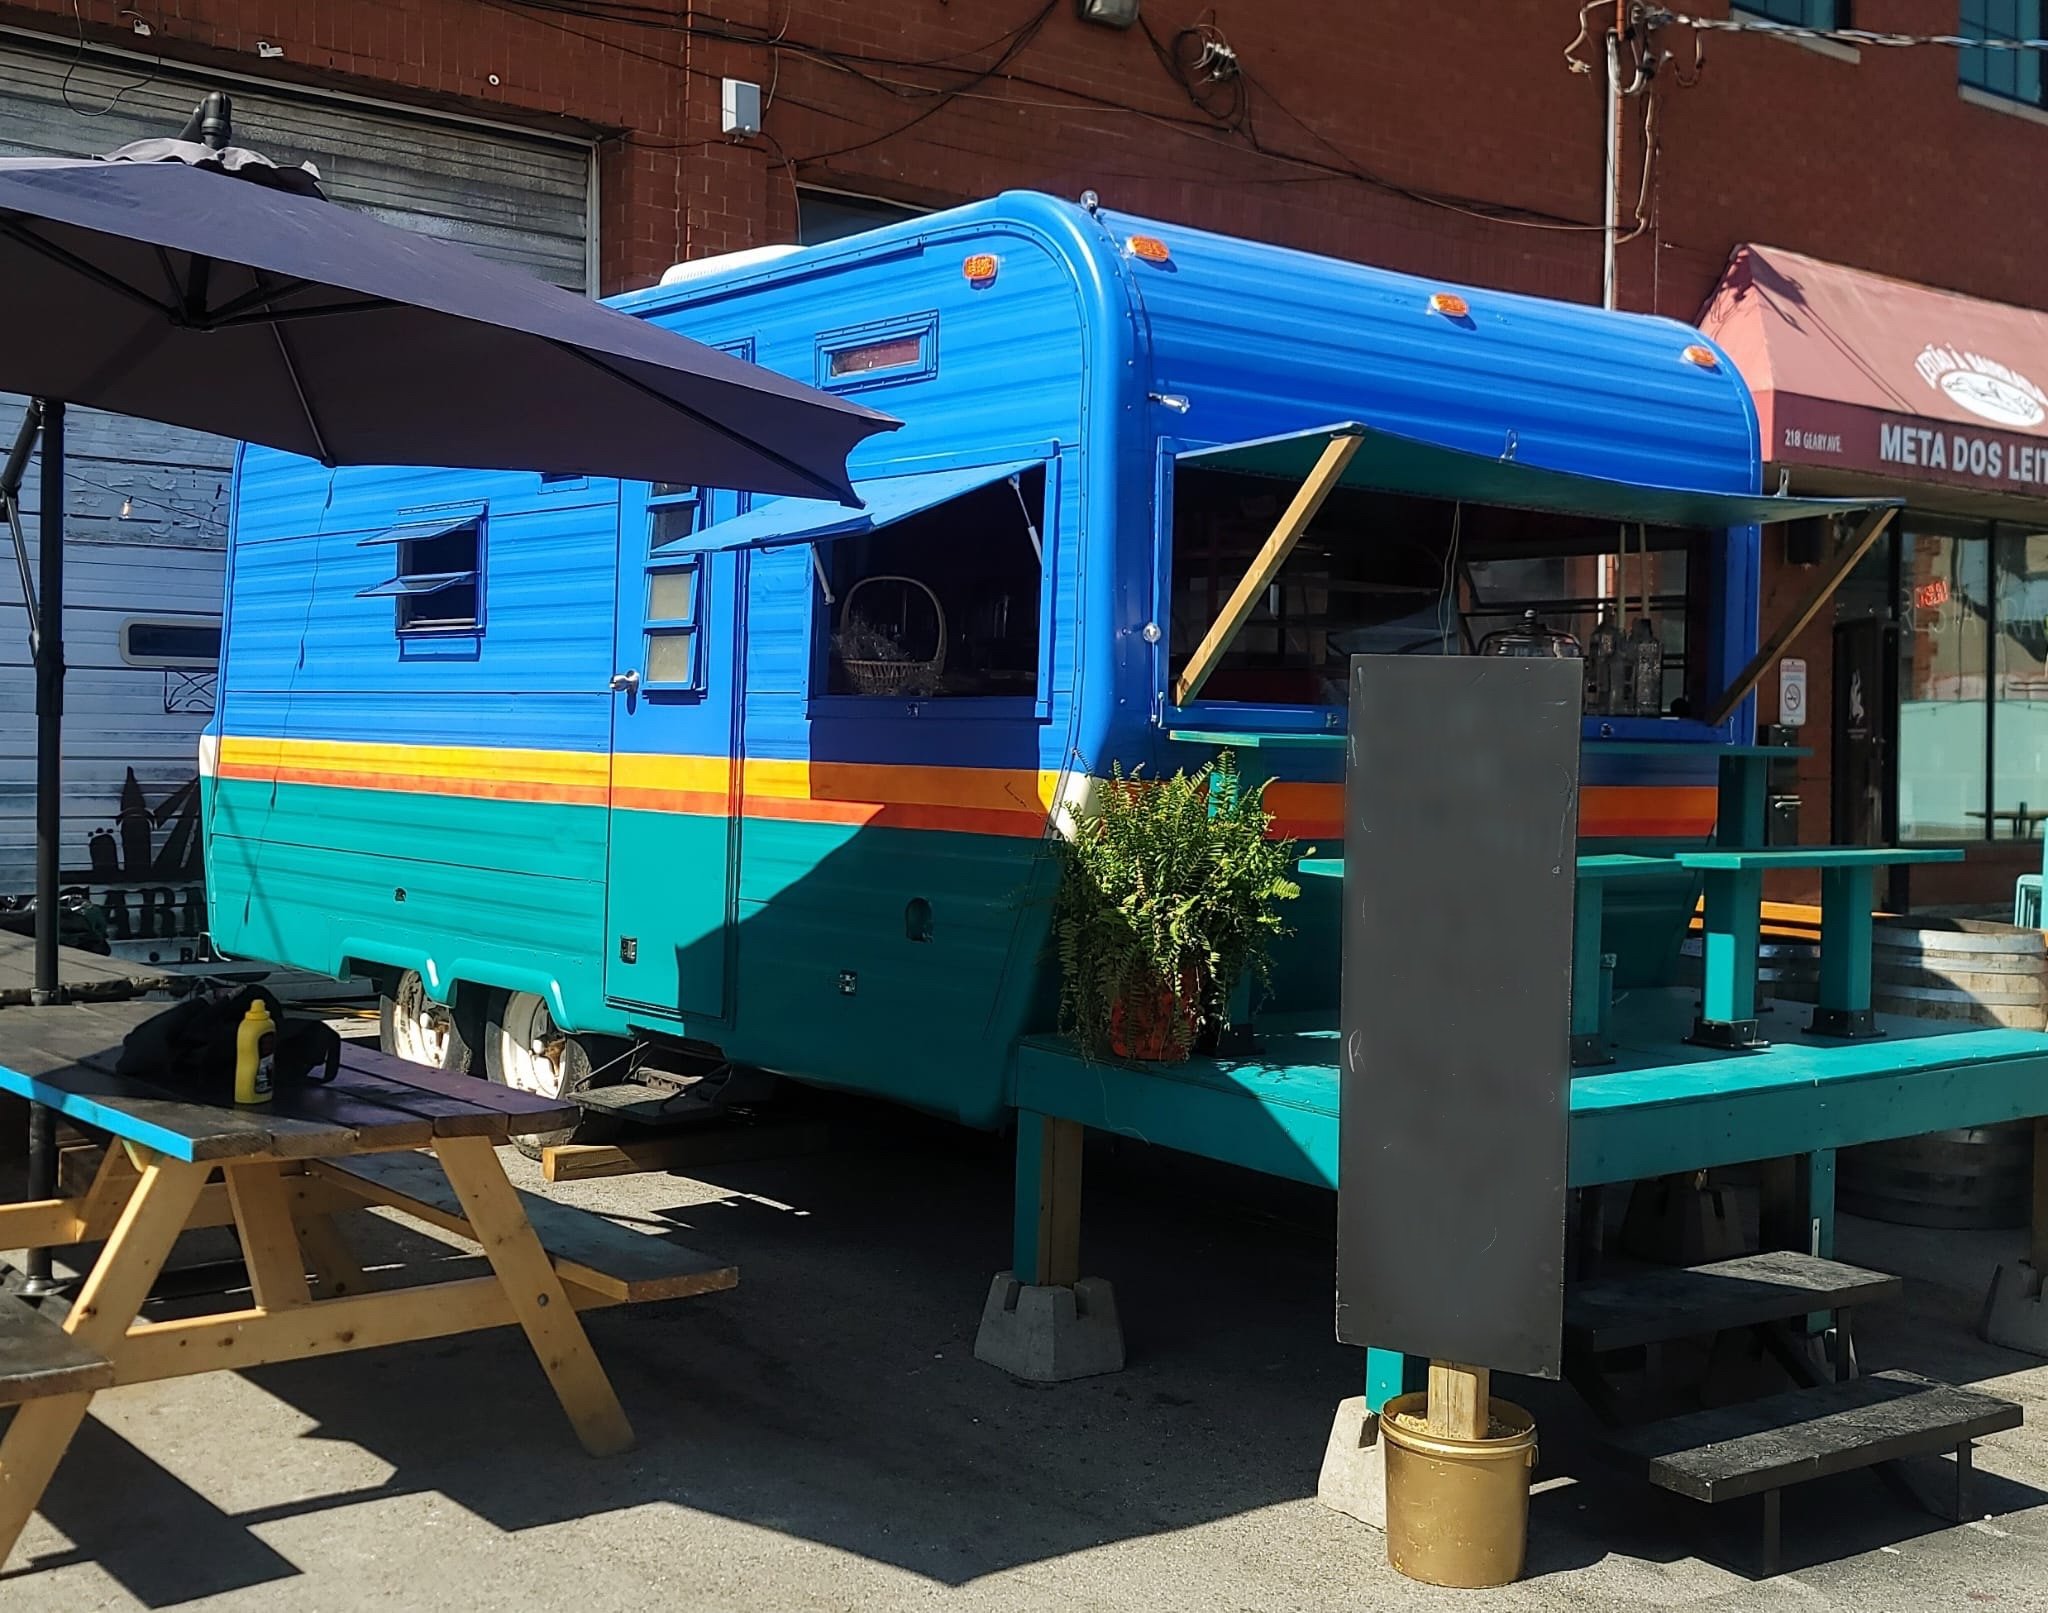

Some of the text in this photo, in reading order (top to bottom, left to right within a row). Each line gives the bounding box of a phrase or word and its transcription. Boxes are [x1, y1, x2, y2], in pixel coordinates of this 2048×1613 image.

[1785, 429, 1801, 447] 218
[1880, 423, 1947, 470] META
[1952, 435, 2003, 478] DOS
